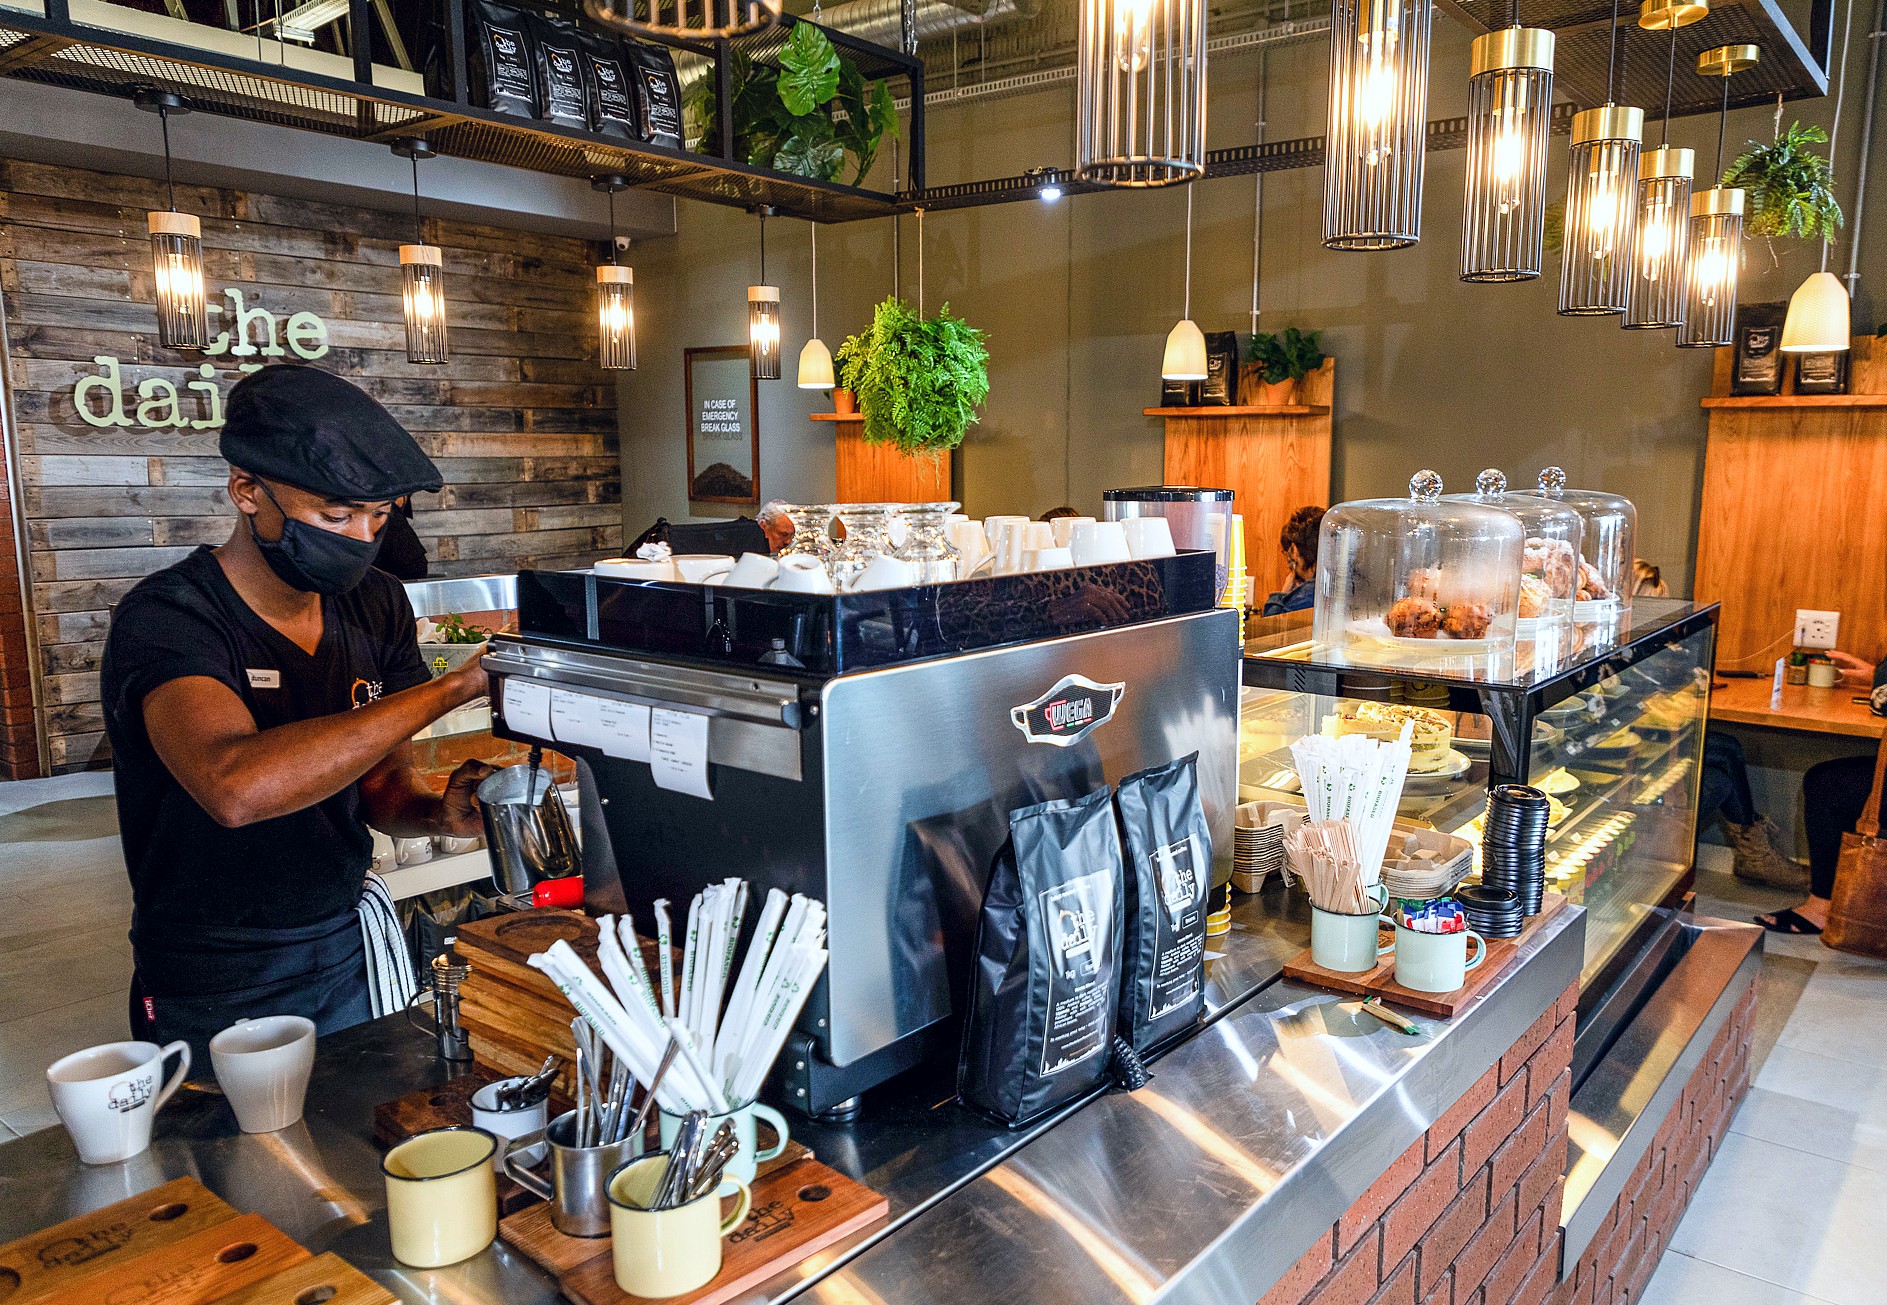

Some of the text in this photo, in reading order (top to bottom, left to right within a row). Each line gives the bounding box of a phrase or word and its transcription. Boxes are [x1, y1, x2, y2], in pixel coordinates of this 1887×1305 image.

[74, 356, 263, 429] dai
[703, 399, 736, 409] IN CASE OF
[701, 422, 741, 432] BREAK GLASS
[702, 411, 739, 421] EMERGENCY
[1051, 698, 1092, 726] WEGA
[129, 1075, 152, 1092] the
[108, 1085, 152, 1110] daily
[747, 1200, 784, 1222] the
[728, 1207, 795, 1243] daily
